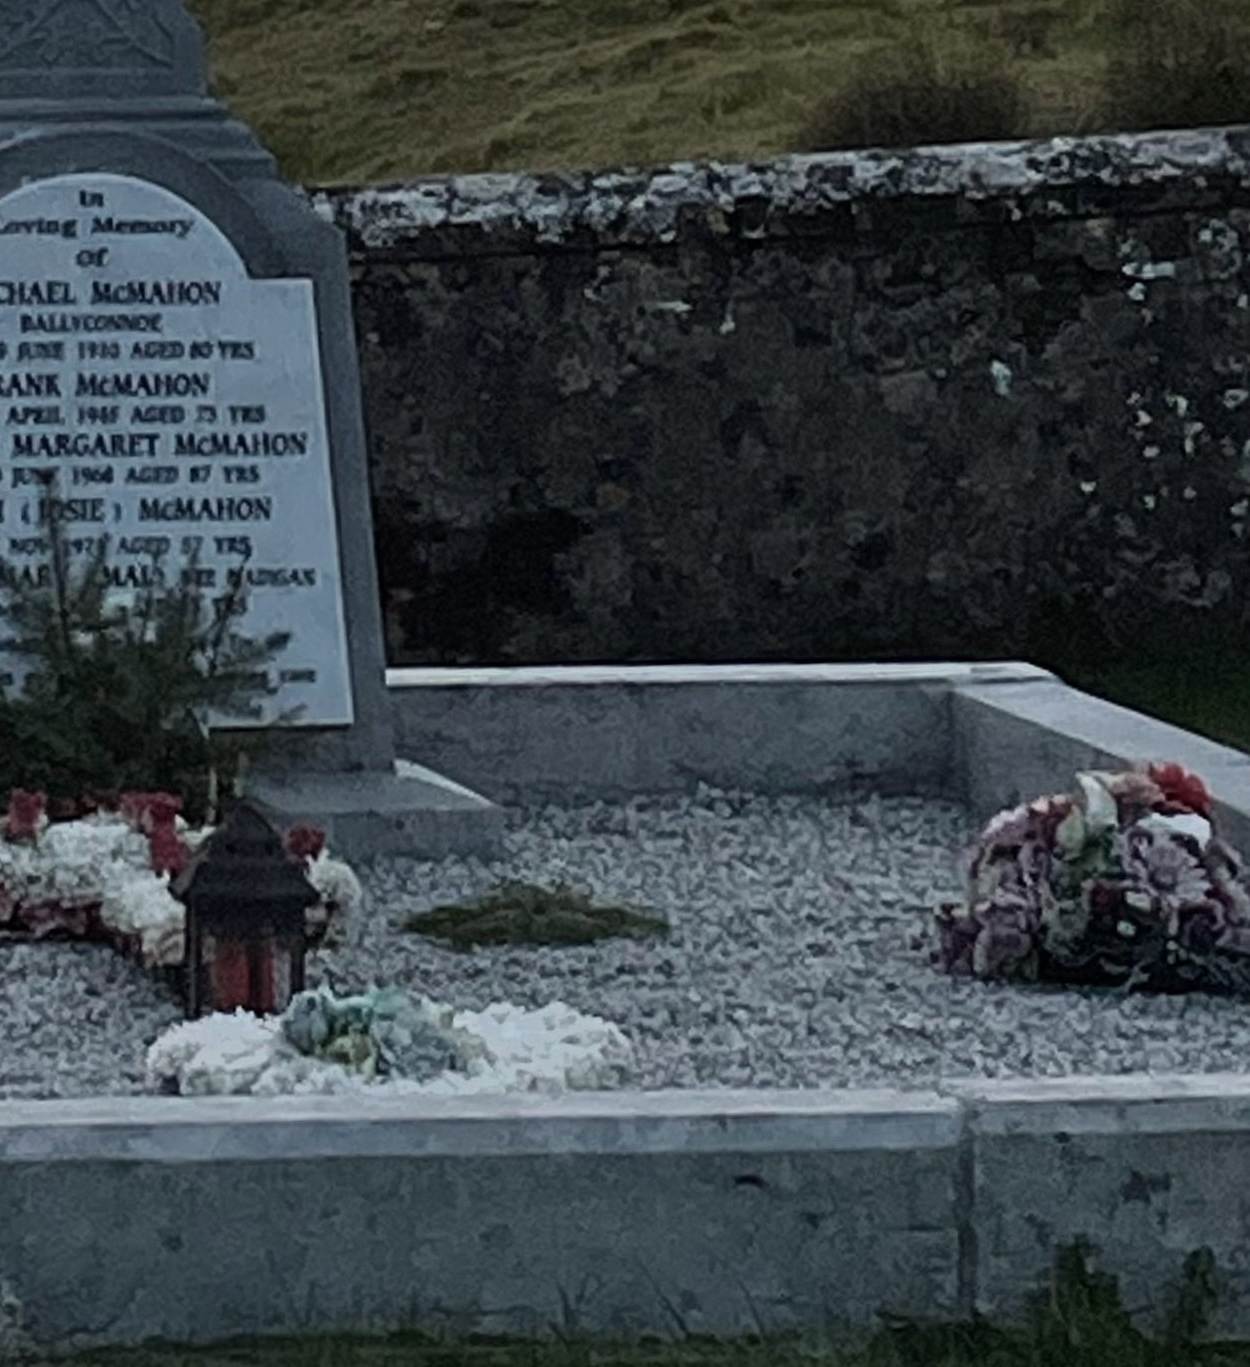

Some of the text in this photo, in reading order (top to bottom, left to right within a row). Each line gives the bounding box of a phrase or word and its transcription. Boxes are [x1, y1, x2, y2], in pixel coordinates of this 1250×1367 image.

[90, 216, 194, 238] Memory
[76, 247, 109, 267] of
[90, 280, 222, 305] McMAHON
[16, 342, 65, 362] JUNE
[130, 341, 185, 360] AGED
[217, 340, 255, 360] YRS
[75, 373, 210, 397] McMAHON
[5, 406, 65, 426] APRIL
[130, 406, 185, 425] AGED
[229, 405, 266, 425] YRS
[11, 433, 160, 458] MARGARET
[173, 432, 308, 456] McMAHON
[124, 465, 179, 484] AGED
[223, 465, 260, 483] YRS
[138, 497, 272, 521] McMAHON
[119, 536, 171, 554] AGED
[213, 535, 252, 556] YRS
